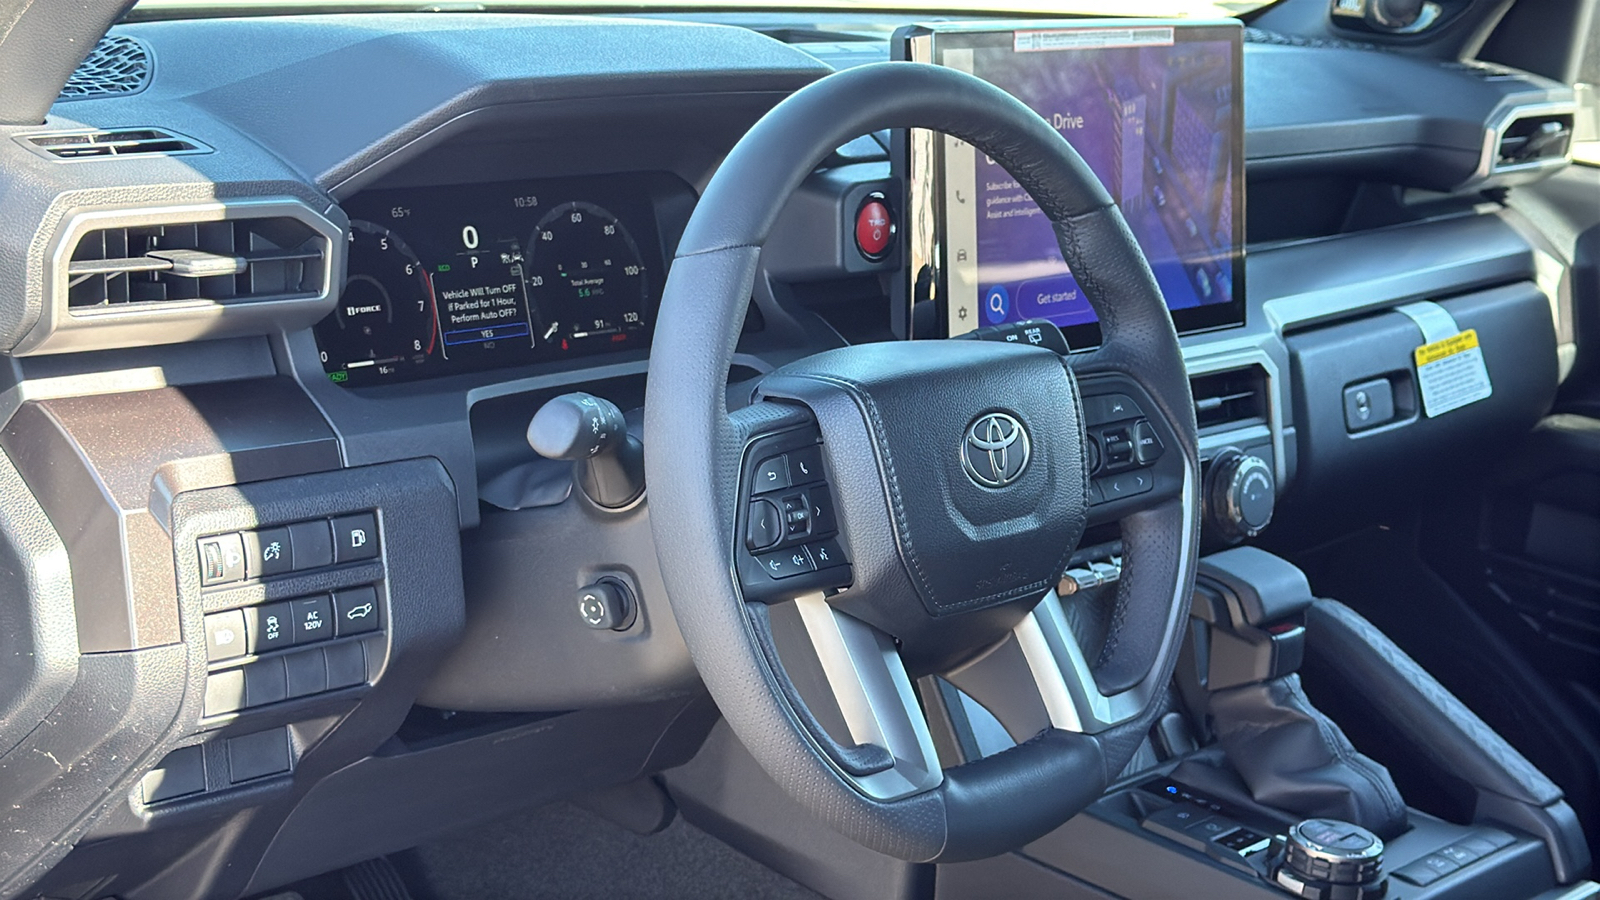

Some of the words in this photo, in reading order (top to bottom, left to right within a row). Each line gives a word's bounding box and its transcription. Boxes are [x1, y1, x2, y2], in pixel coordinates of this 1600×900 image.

[1053, 112, 1084, 130] Drive
[986, 181, 1012, 191] Subscribe
[514, 197, 538, 208] 10:58
[986, 195, 1011, 208] guidance
[571, 213, 582, 223] 60
[986, 210, 1002, 219] Assist
[1003, 209, 1014, 218] and
[604, 225, 615, 235] 80
[462, 225, 479, 249] 0
[542, 231, 553, 241] 40
[381, 238, 388, 250] 5
[470, 256, 479, 268] P
[405, 264, 413, 275] 6
[624, 265, 639, 276] 100
[532, 276, 543, 286] 20
[442, 289, 470, 300] Vehicle
[469, 287, 485, 297] Will
[485, 286, 502, 296] Turn
[502, 284, 517, 293] OFF
[578, 288, 591, 298] 5.6
[1037, 292, 1051, 305] Get
[1051, 289, 1077, 303] started
[417, 301, 425, 312] 7
[454, 300, 479, 311] Parked
[480, 299, 490, 308] for
[491, 299, 495, 307] 1
[496, 297, 517, 306] Hour,
[451, 314, 480, 324] Perform
[481, 312, 498, 320] Auto
[498, 308, 517, 318] OFF?
[624, 312, 639, 323] 120
[594, 319, 604, 329] 91
[481, 329, 494, 338] YES
[1024, 327, 1041, 336] REAR
[1006, 334, 1018, 342] ON
[414, 339, 422, 351] 8
[320, 351, 328, 363] 0
[379, 366, 388, 374] 16
[307, 611, 318, 620] AC
[304, 620, 323, 630] 120V
[267, 632, 279, 640] OFF
